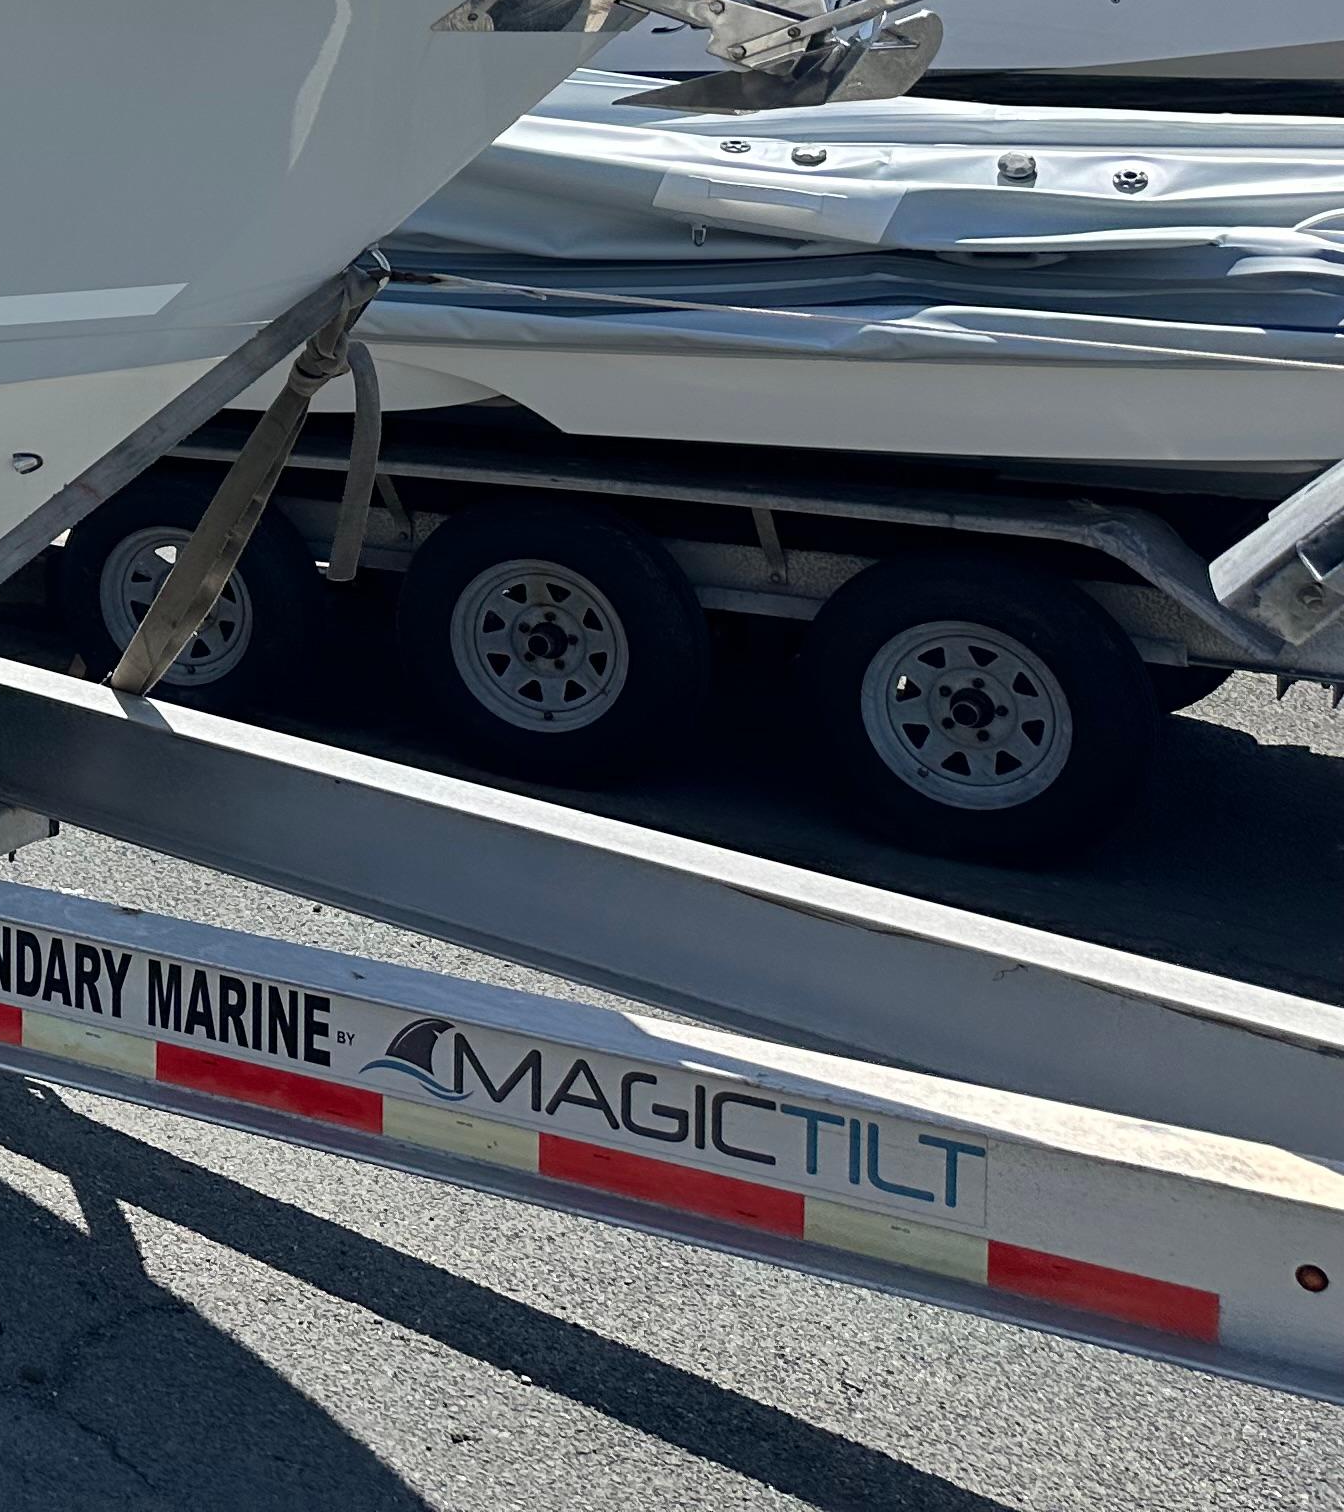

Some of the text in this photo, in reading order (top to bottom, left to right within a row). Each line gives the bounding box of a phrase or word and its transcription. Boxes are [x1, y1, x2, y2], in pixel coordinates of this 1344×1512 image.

[147, 959, 332, 1068] MARINE
[336, 1030, 356, 1046] BY
[454, 1032, 987, 1208] MAGICTILT
